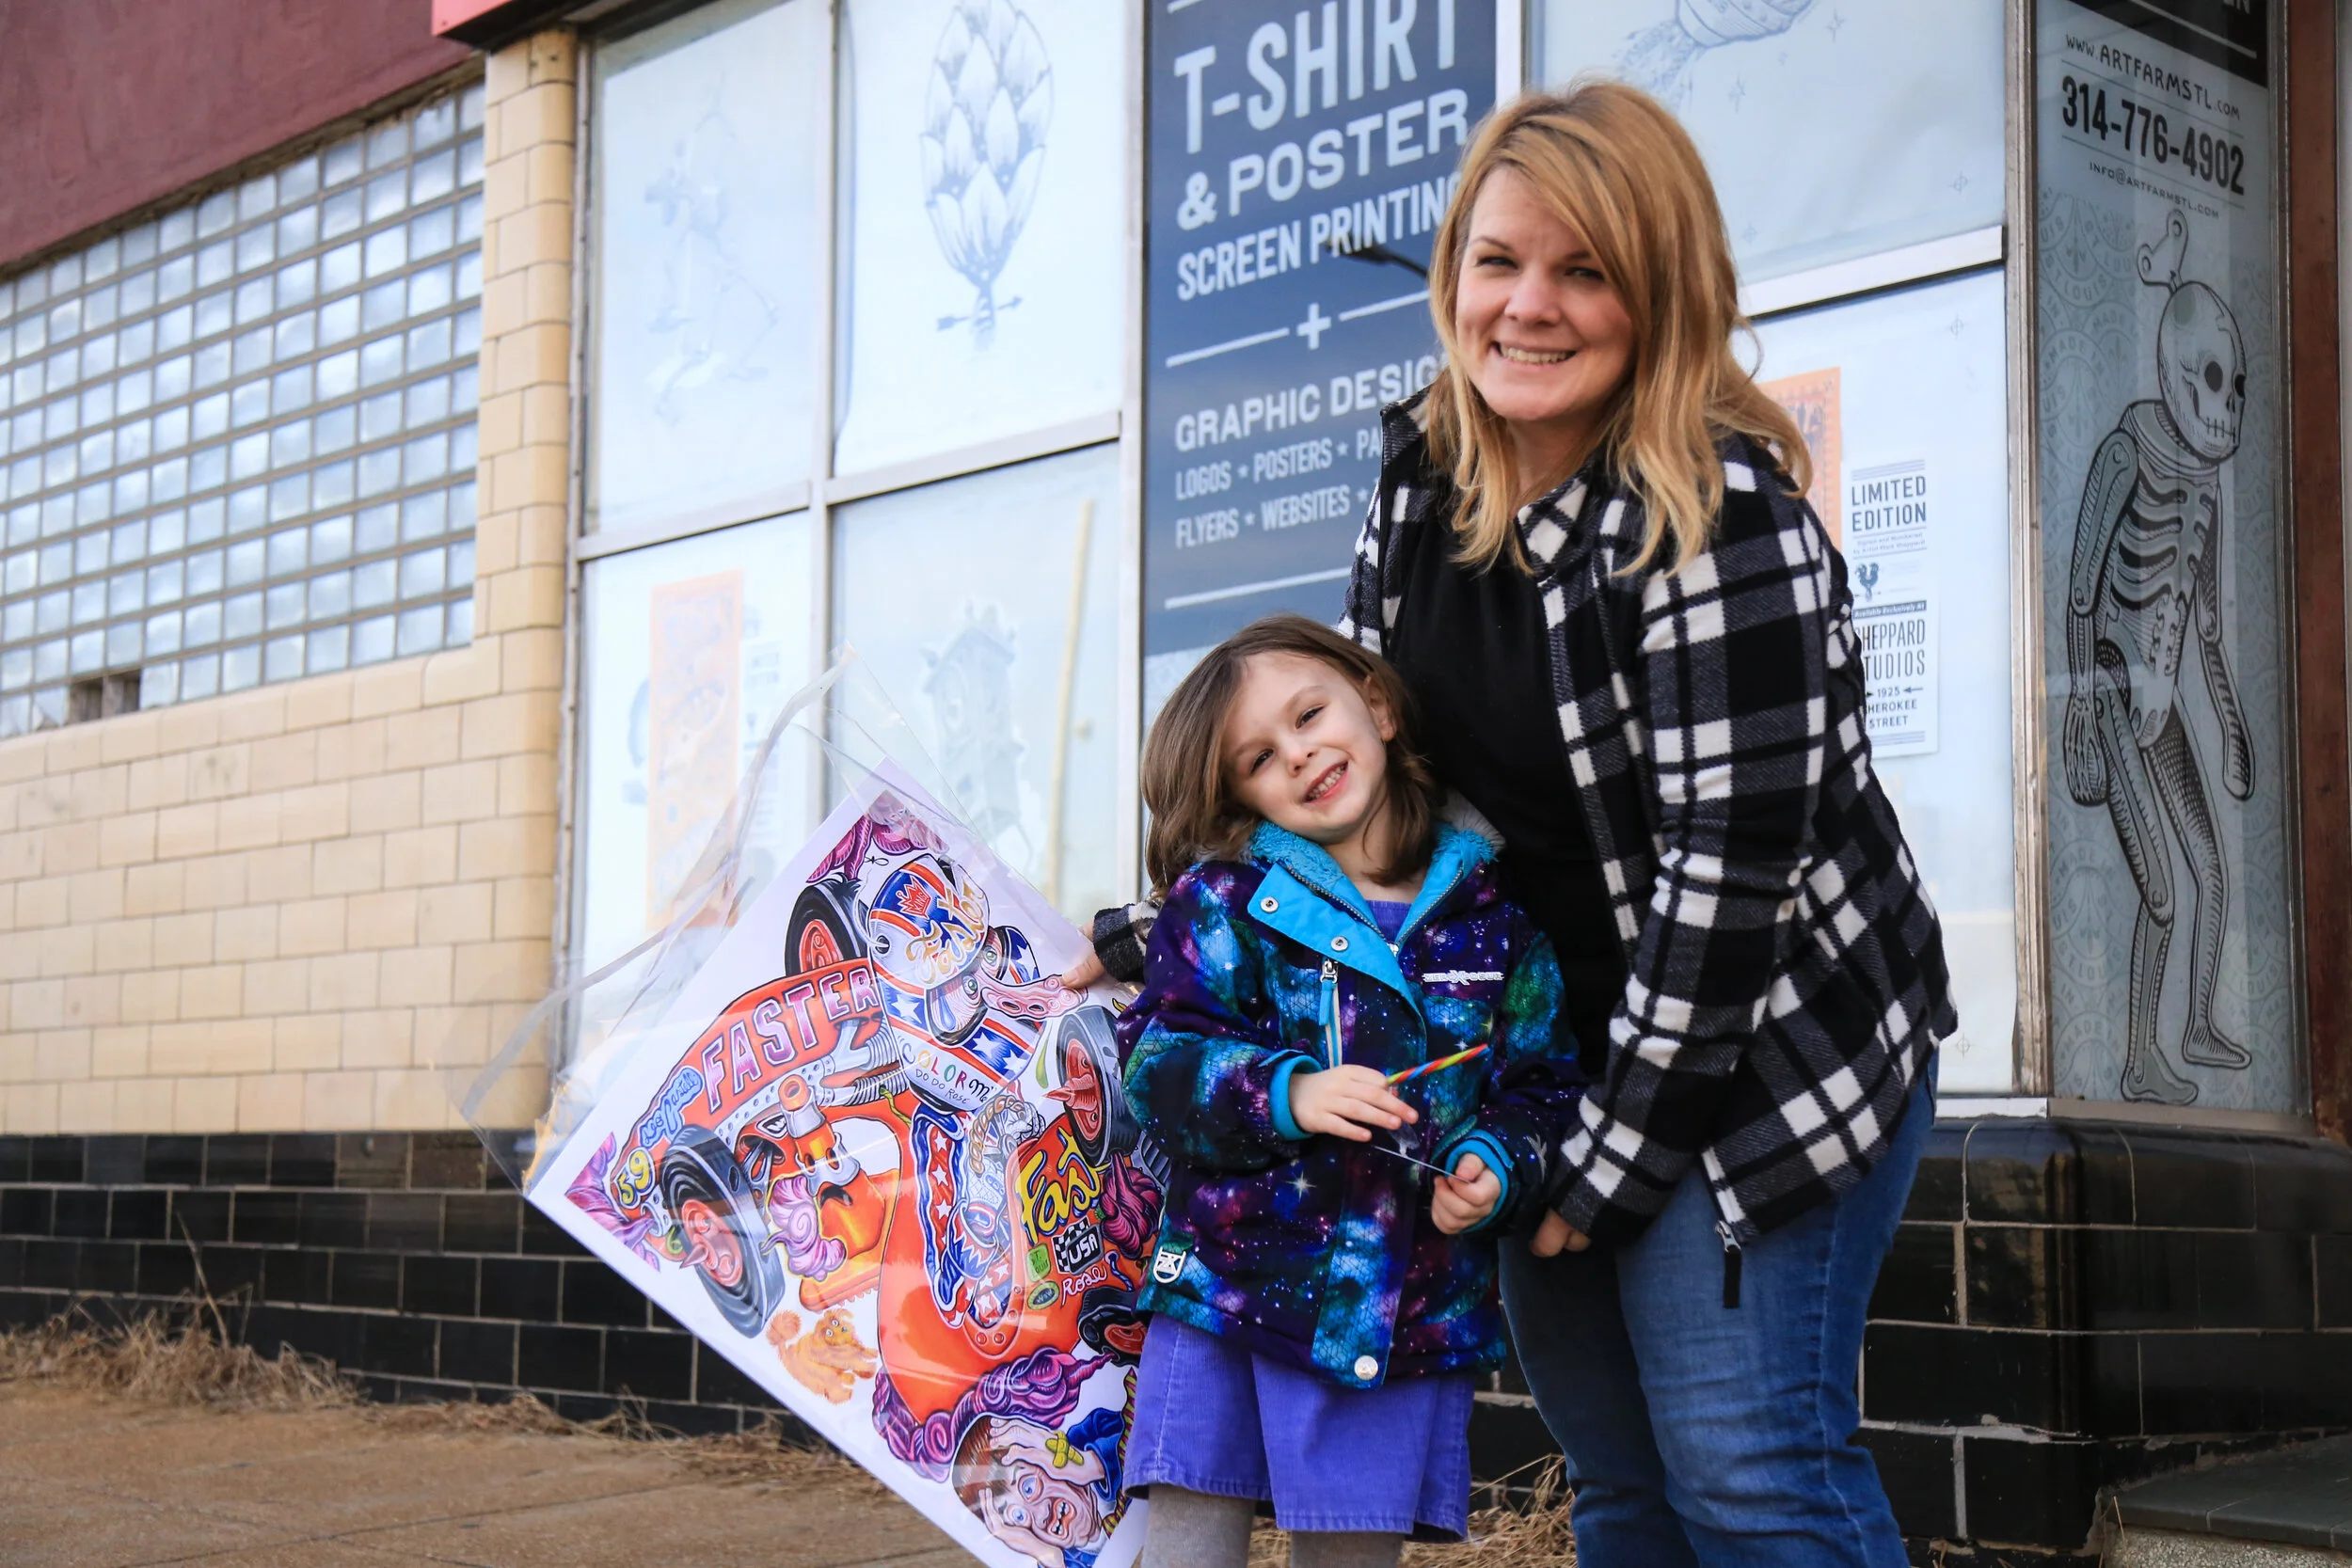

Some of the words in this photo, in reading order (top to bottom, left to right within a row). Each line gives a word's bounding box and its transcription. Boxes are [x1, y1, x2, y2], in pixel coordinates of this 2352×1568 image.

[1177, 172, 1217, 230] &
[1229, 88, 1469, 216] POSTER
[2061, 75, 2245, 196] 314-776-4902
[1177, 220, 1300, 301] SCREEN
[1176, 383, 1321, 452] GRAPHIC
[1330, 353, 1449, 416] DESIG
[1176, 461, 1232, 500] LOGOS
[1253, 437, 1332, 483] POSTERS
[1851, 475, 1926, 507] LIMITED
[1176, 508, 1239, 549] FLYERS
[1261, 485, 1350, 531] WEBSITES
[1851, 501, 1926, 532] EDITION
[1864, 649, 1925, 682] TUDIOS
[1877, 687, 1900, 698] 1925
[1867, 699, 1917, 714] HEROKEE
[1869, 715, 1908, 729] STREET
[701, 967, 880, 1115] FASTER
[915, 1069, 930, 1081] DO
[931, 1079, 945, 1089] DO
[617, 1150, 652, 1206] 59
[1015, 1127, 1110, 1243] Fast
[1069, 1233, 1098, 1264] USA
